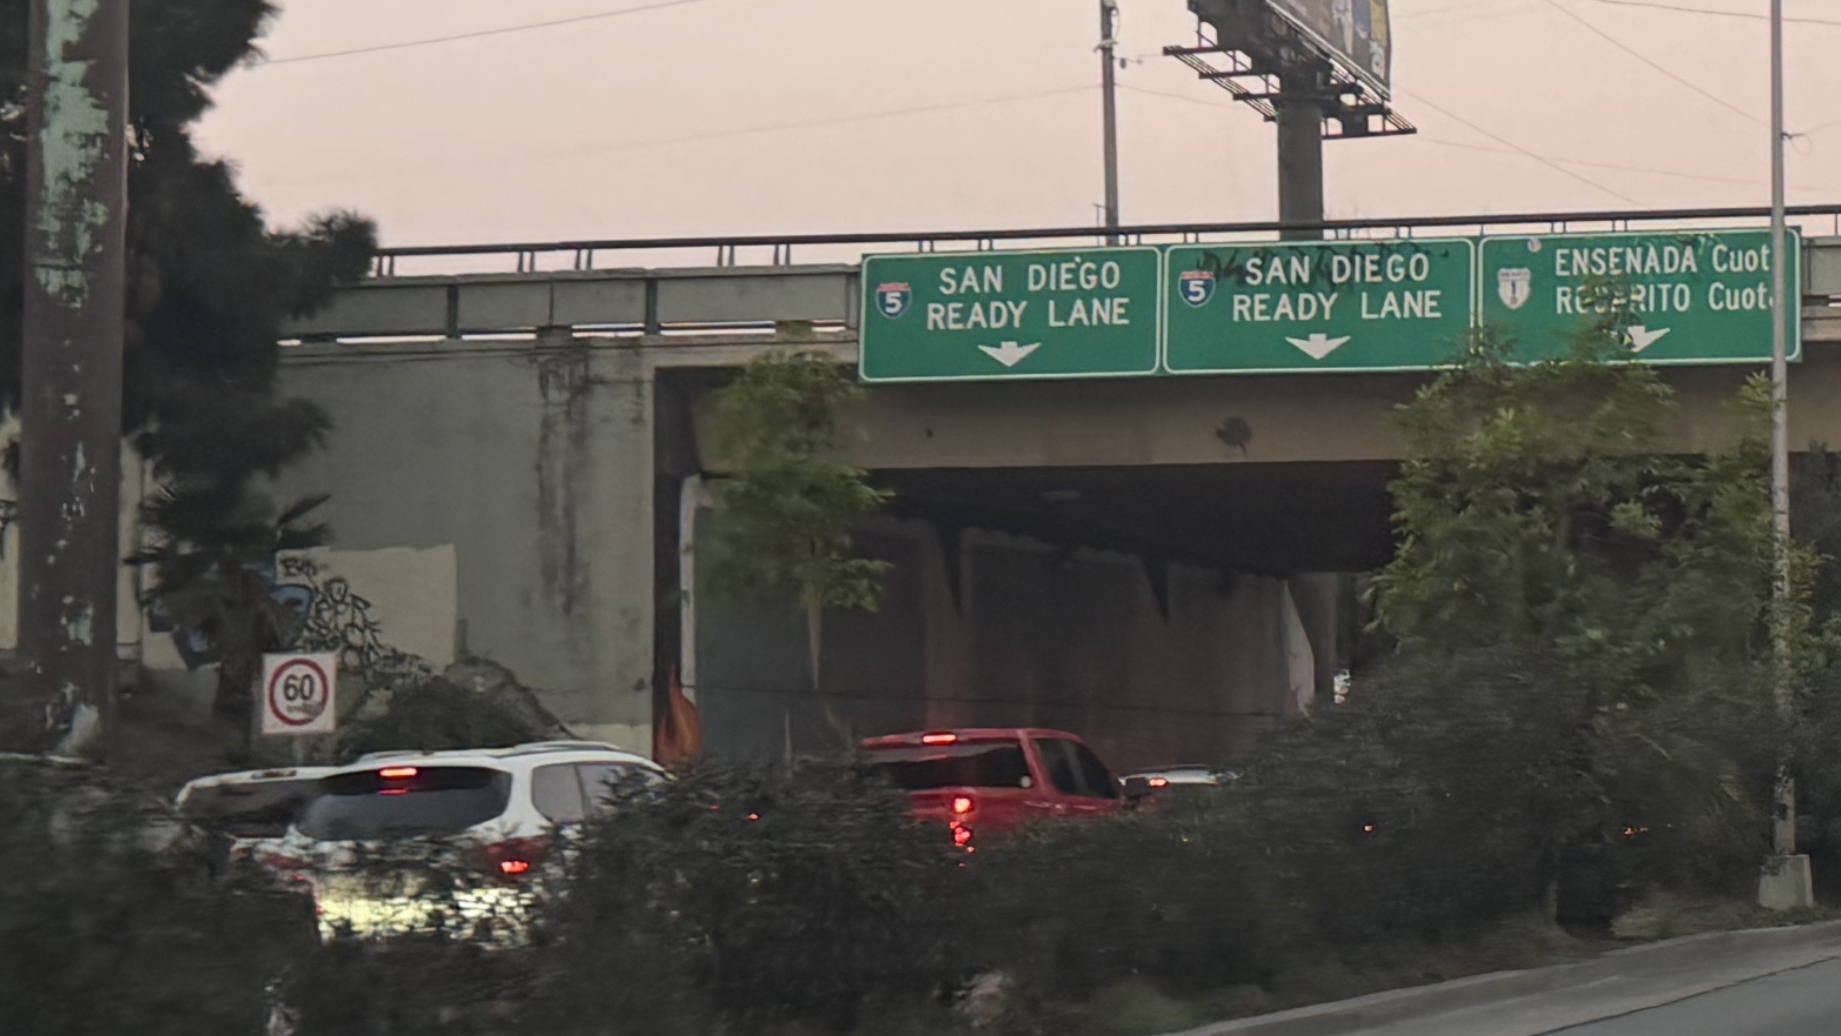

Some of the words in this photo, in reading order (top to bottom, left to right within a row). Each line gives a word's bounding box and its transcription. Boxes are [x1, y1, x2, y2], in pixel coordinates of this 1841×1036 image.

[1245, 255, 1310, 286] SAN
[1331, 252, 1430, 284] DIEGO
[1555, 245, 1698, 276] ENSENADA
[1712, 243, 1771, 273] Cuot
[938, 264, 1002, 295] SAN
[1027, 260, 1121, 292] DIEGO
[1187, 280, 1207, 303] 5
[885, 292, 903, 314] 5
[1232, 291, 1339, 322] READY
[1360, 290, 1442, 320] LANE
[1708, 281, 1774, 311] Cuot
[926, 299, 1028, 331] READY
[1047, 297, 1130, 328] LANE
[283, 673, 315, 702] 60
